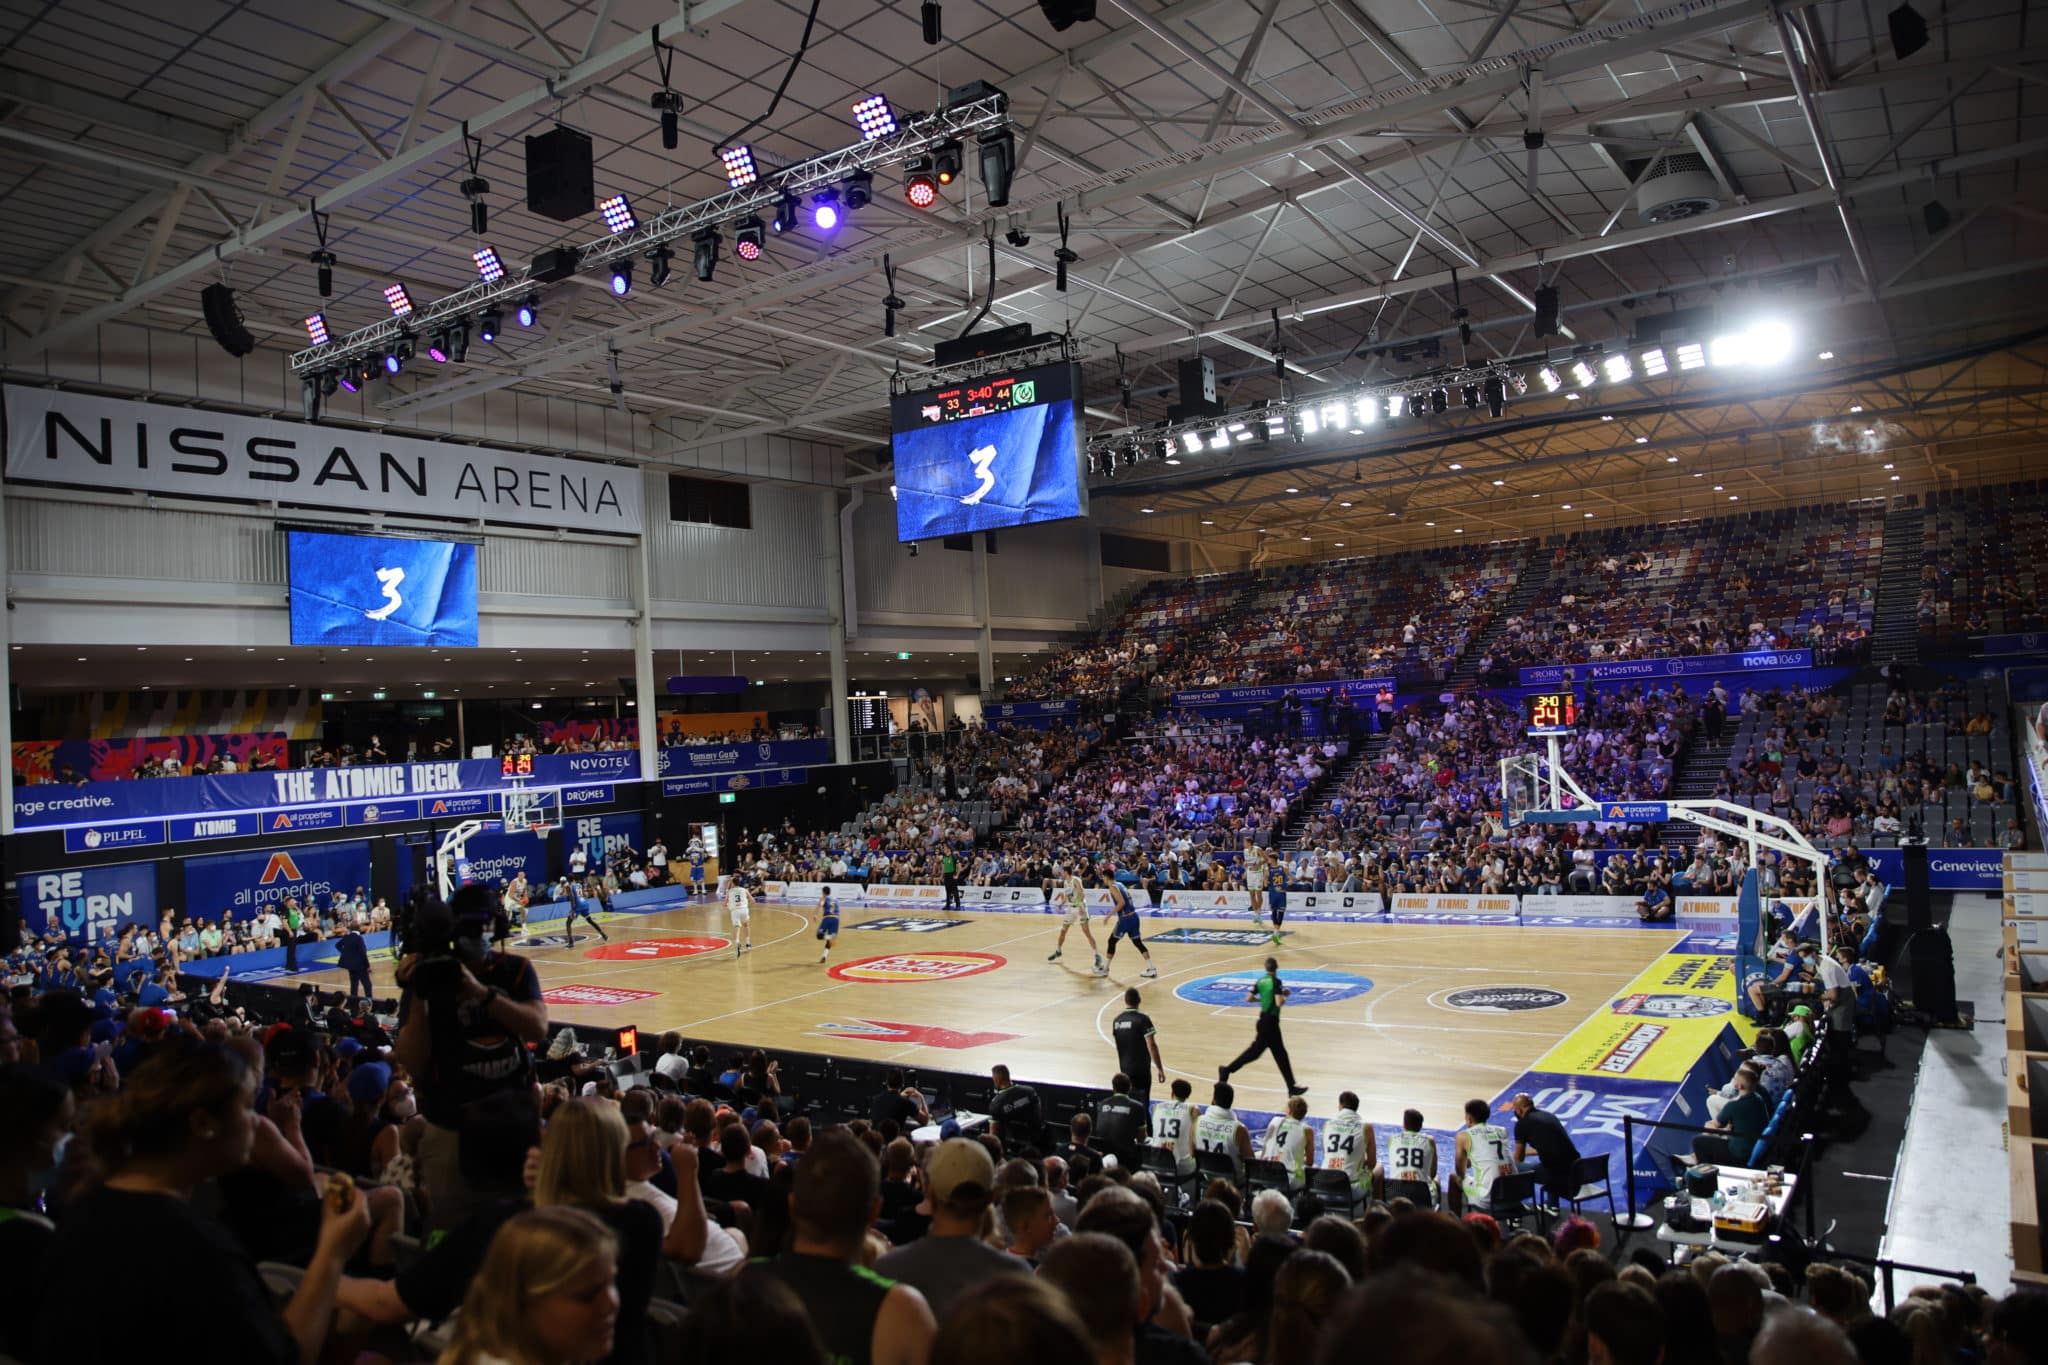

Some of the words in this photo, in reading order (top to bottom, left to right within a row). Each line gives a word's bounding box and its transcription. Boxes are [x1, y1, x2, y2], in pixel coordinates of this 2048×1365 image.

[967, 385, 993, 402] 3:40
[997, 388, 1010, 400] 44
[946, 398, 960, 411] 33
[45, 410, 428, 497] NISSAN
[454, 462, 624, 518] ARENA
[959, 443, 998, 506] 3
[363, 566, 406, 622] 3
[1743, 656, 1778, 668] nova
[1778, 653, 1802, 665] 106.9
[1609, 664, 1653, 676] HOSTPLUS
[1297, 686, 1330, 696] HOSTPLU
[1356, 679, 1393, 691] Genevieve
[1232, 688, 1272, 698] NOVOTEL
[1533, 707, 1559, 727] 24
[689, 751, 717, 762] Tommy
[718, 748, 739, 760] Gun's
[517, 760, 531, 773] 24
[570, 756, 631, 770] NOVOTEL
[273, 770, 316, 804] THE
[324, 766, 406, 801] ATOMIC
[411, 762, 463, 793] DECK
[666, 782, 681, 792] binge
[48, 795, 115, 812] creative.
[452, 797, 482, 808] properties
[298, 810, 333, 821] properties
[1630, 806, 1662, 815] properties
[194, 818, 236, 838] ATOMIC
[577, 817, 602, 839] RE
[103, 829, 147, 843] PILPEL
[467, 855, 528, 871] echnology
[1930, 859, 2003, 873] Genevieve
[37, 871, 83, 901] RE
[1272, 874, 1284, 886] 20
[234, 887, 250, 906] all
[254, 880, 331, 906] properties
[734, 893, 742, 903] 3
[1397, 898, 1429, 910] ATOMIC
[1436, 898, 1469, 911] ATOMIC
[1477, 899, 1510, 911] ATOMIC
[1682, 900, 1721, 913] ATOMIC
[39, 891, 133, 934] TURN
[863, 963, 959, 975] HUNGRY
[1597, 1022, 1668, 1073] MONSTER
[1158, 1118, 1181, 1139] 13
[1275, 1130, 1289, 1149] 4
[1327, 1133, 1355, 1155] 34
[1488, 1140, 1504, 1160] 7
[1395, 1148, 1425, 1169] 38
